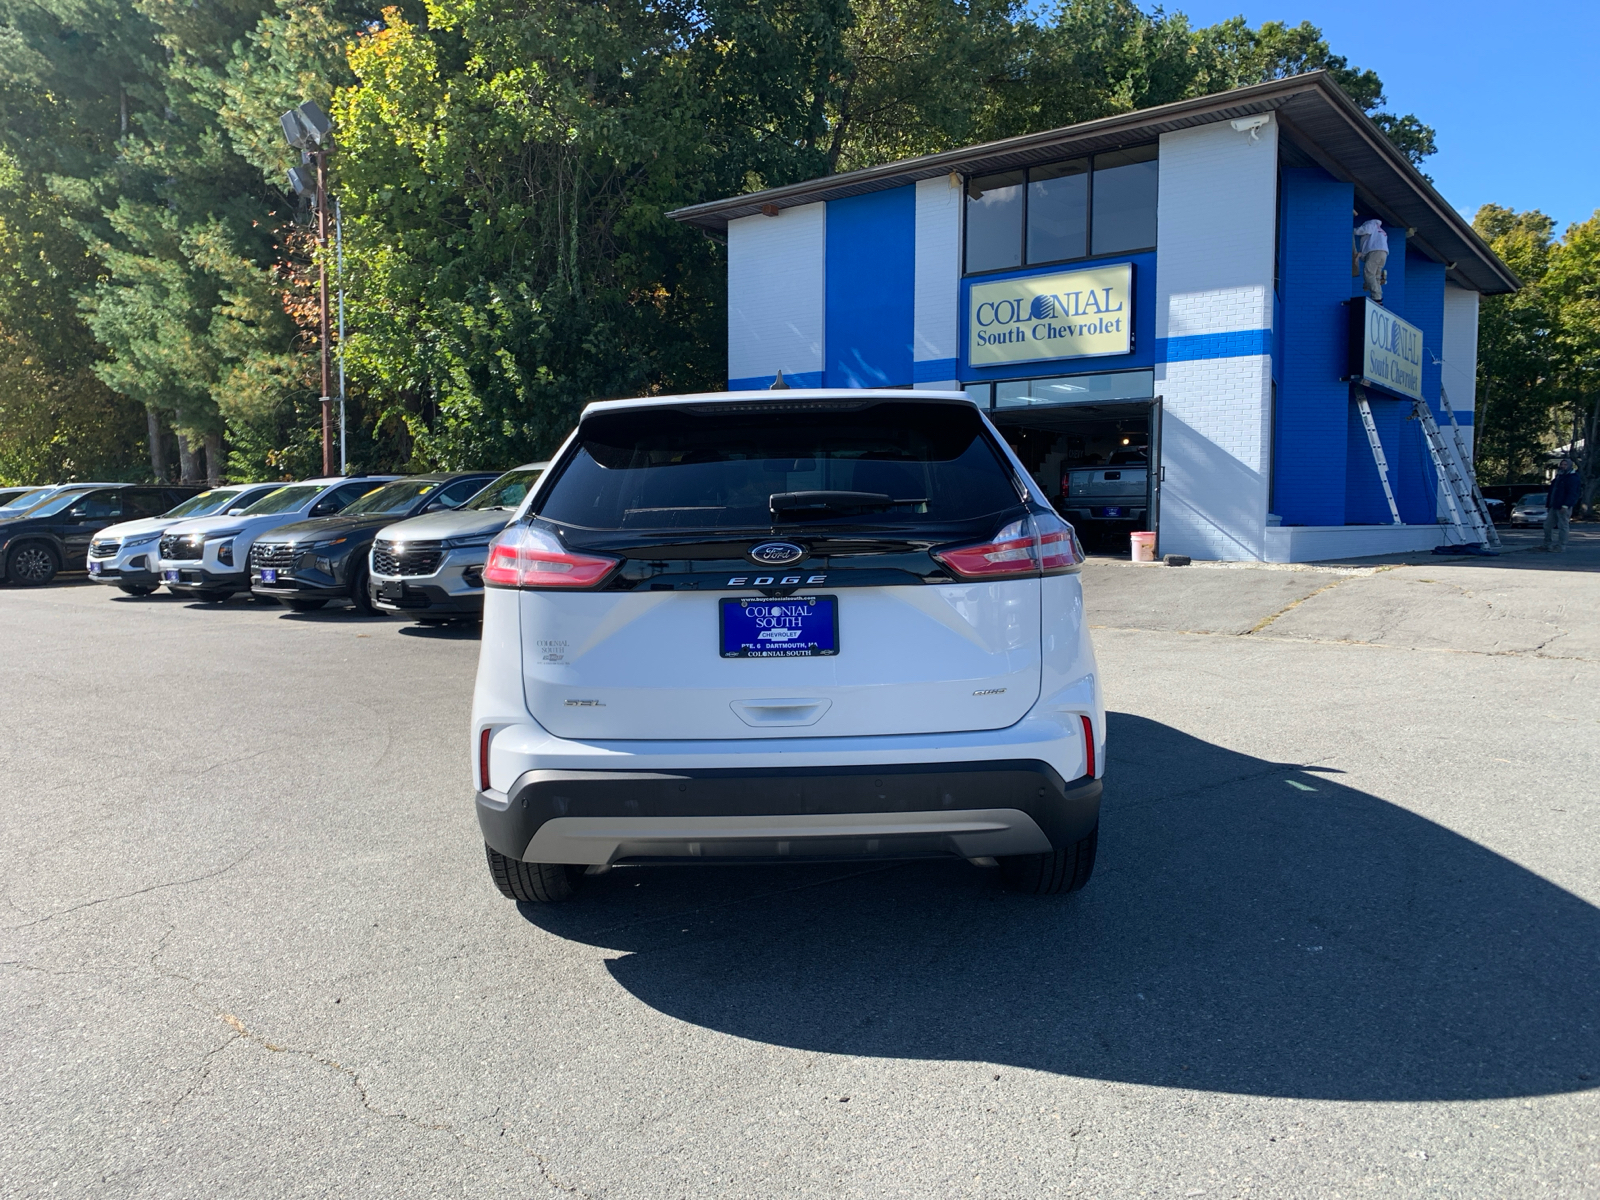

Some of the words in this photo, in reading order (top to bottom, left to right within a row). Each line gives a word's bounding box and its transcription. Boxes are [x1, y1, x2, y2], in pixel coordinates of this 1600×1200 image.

[976, 287, 1122, 327] COLONIAL
[977, 326, 1026, 346] South
[1032, 317, 1122, 341] Chevrolet
[1370, 309, 1419, 366] COLONIAL
[1370, 350, 1389, 380] South
[1391, 360, 1418, 392] Chevrolet
[763, 547, 791, 559] Ford
[727, 575, 828, 586] EDGE
[745, 605, 813, 618] COLONIAL
[756, 617, 802, 628] SOUTH
[563, 699, 606, 707] SEL
